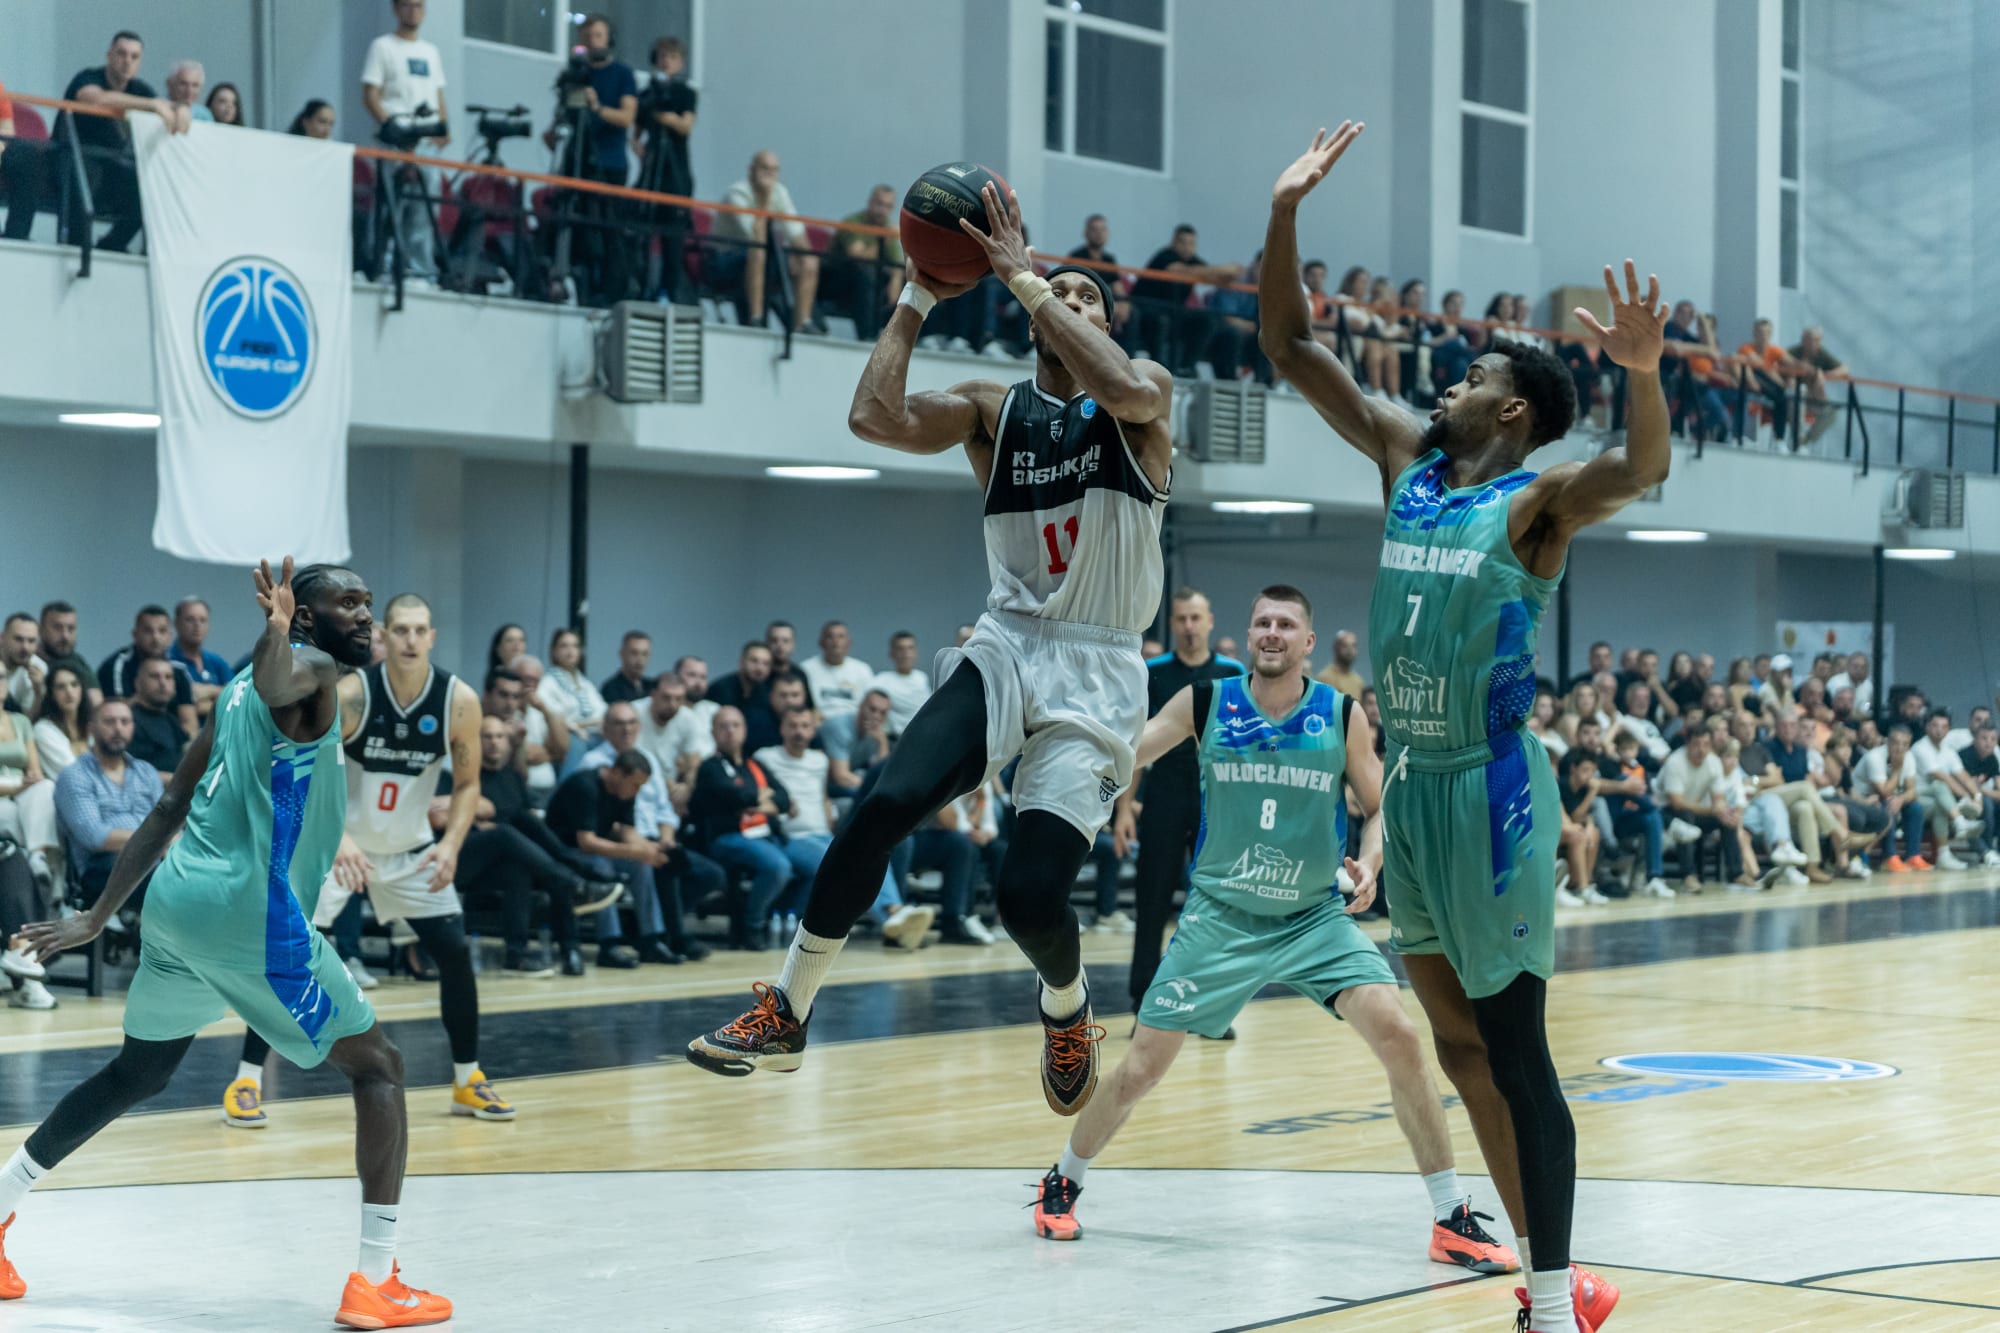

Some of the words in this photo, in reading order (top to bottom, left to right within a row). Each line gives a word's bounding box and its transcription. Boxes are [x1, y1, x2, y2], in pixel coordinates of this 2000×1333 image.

[1043, 515, 1080, 574] 11
[1404, 595, 1422, 637] 7
[1212, 762, 1335, 793] WŁOCŁAWEK
[378, 781, 399, 812] 0
[1260, 798, 1278, 831] 8
[1227, 847, 1305, 886] Anwil
[1219, 879, 1256, 894] GRUPA
[1258, 886, 1298, 900] ORLEN
[1155, 996, 1196, 1012] ORLEN
